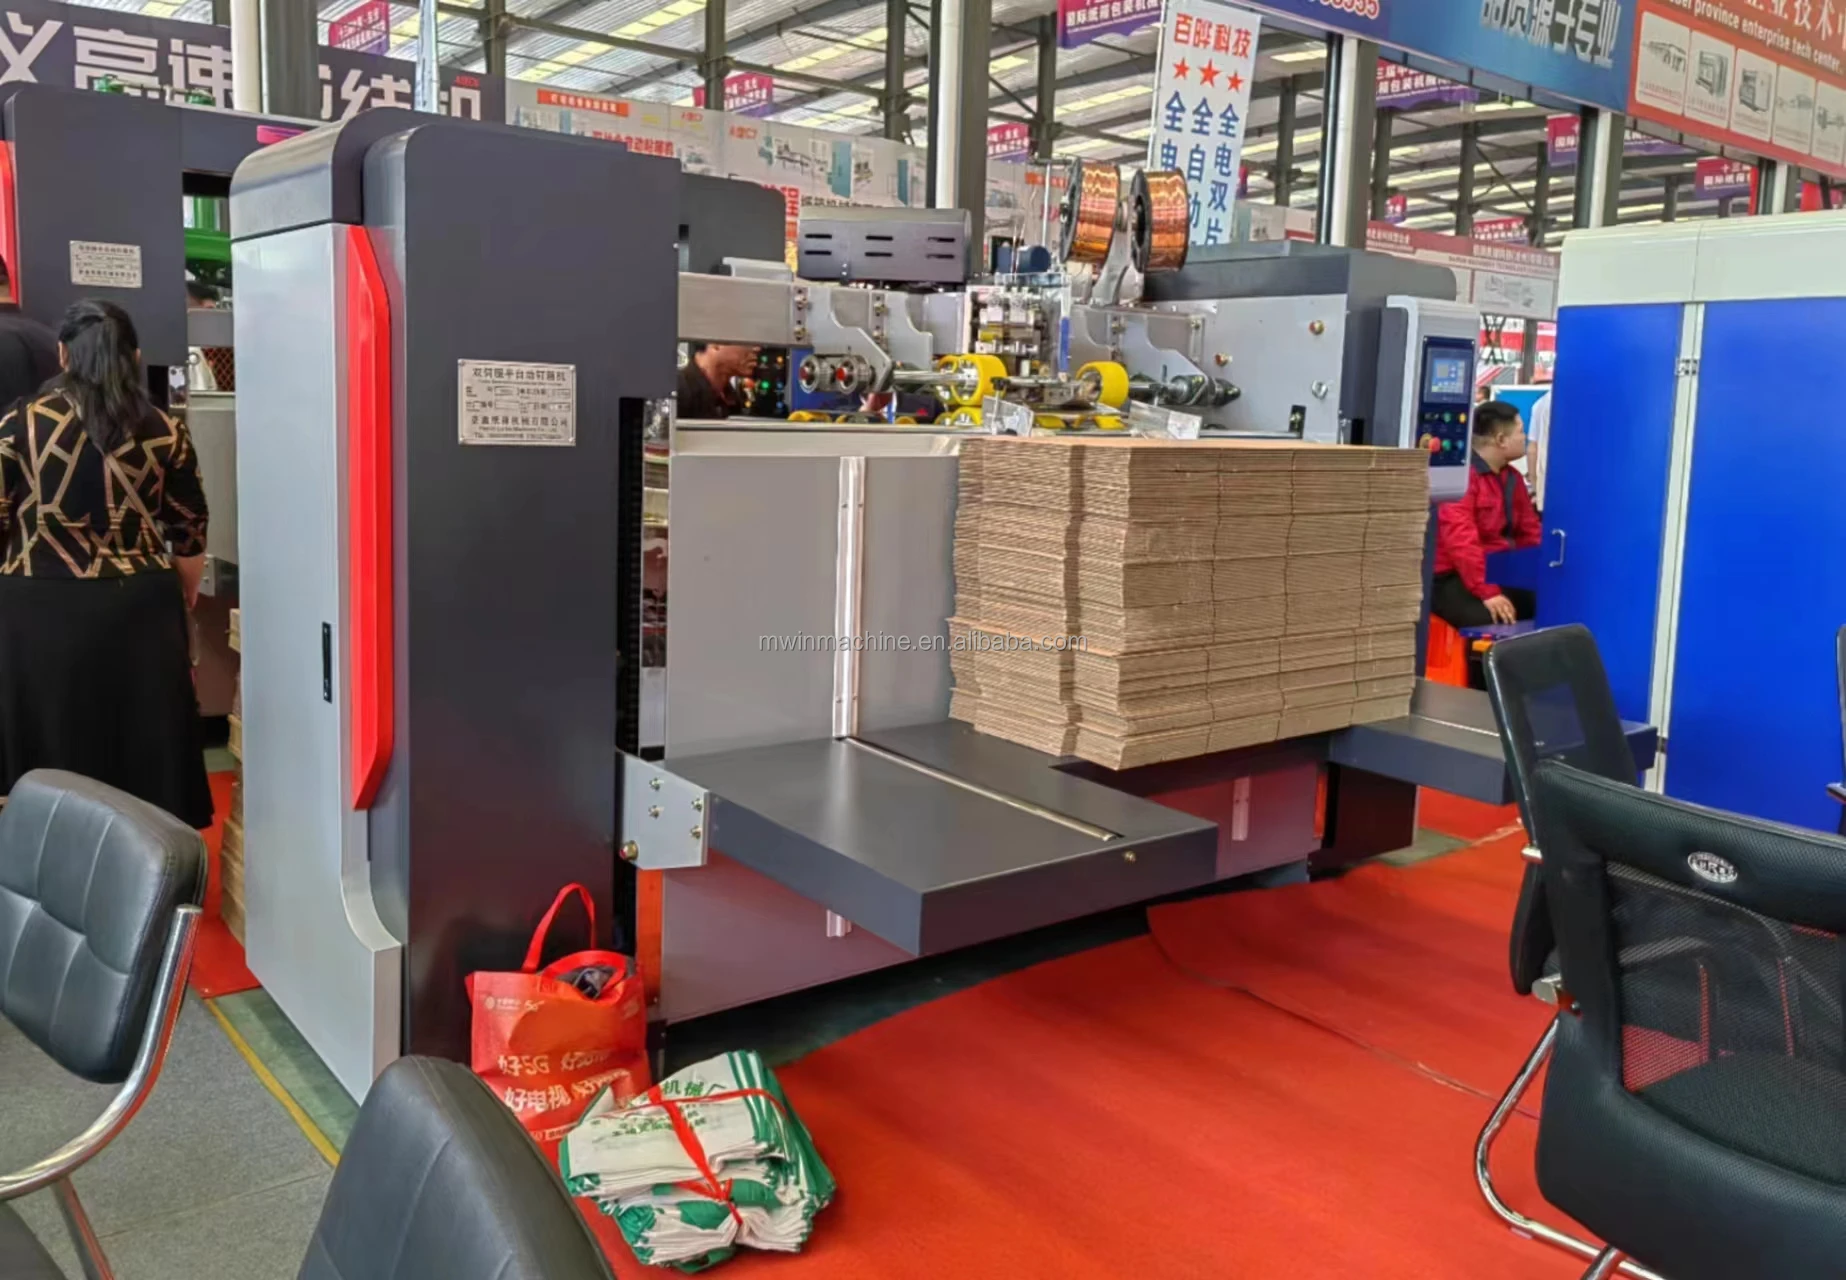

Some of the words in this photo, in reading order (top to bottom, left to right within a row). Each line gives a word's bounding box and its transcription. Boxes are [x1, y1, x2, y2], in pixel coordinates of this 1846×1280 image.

[1173, 12, 1252, 58] 百晔科技
[1694, 0, 1740, 29] province
[1741, 17, 1790, 51] enterprise
[1791, 36, 1812, 61] tech
[1206, 103, 1240, 245] 全电双片
[503, 1083, 571, 1112] 好电视
